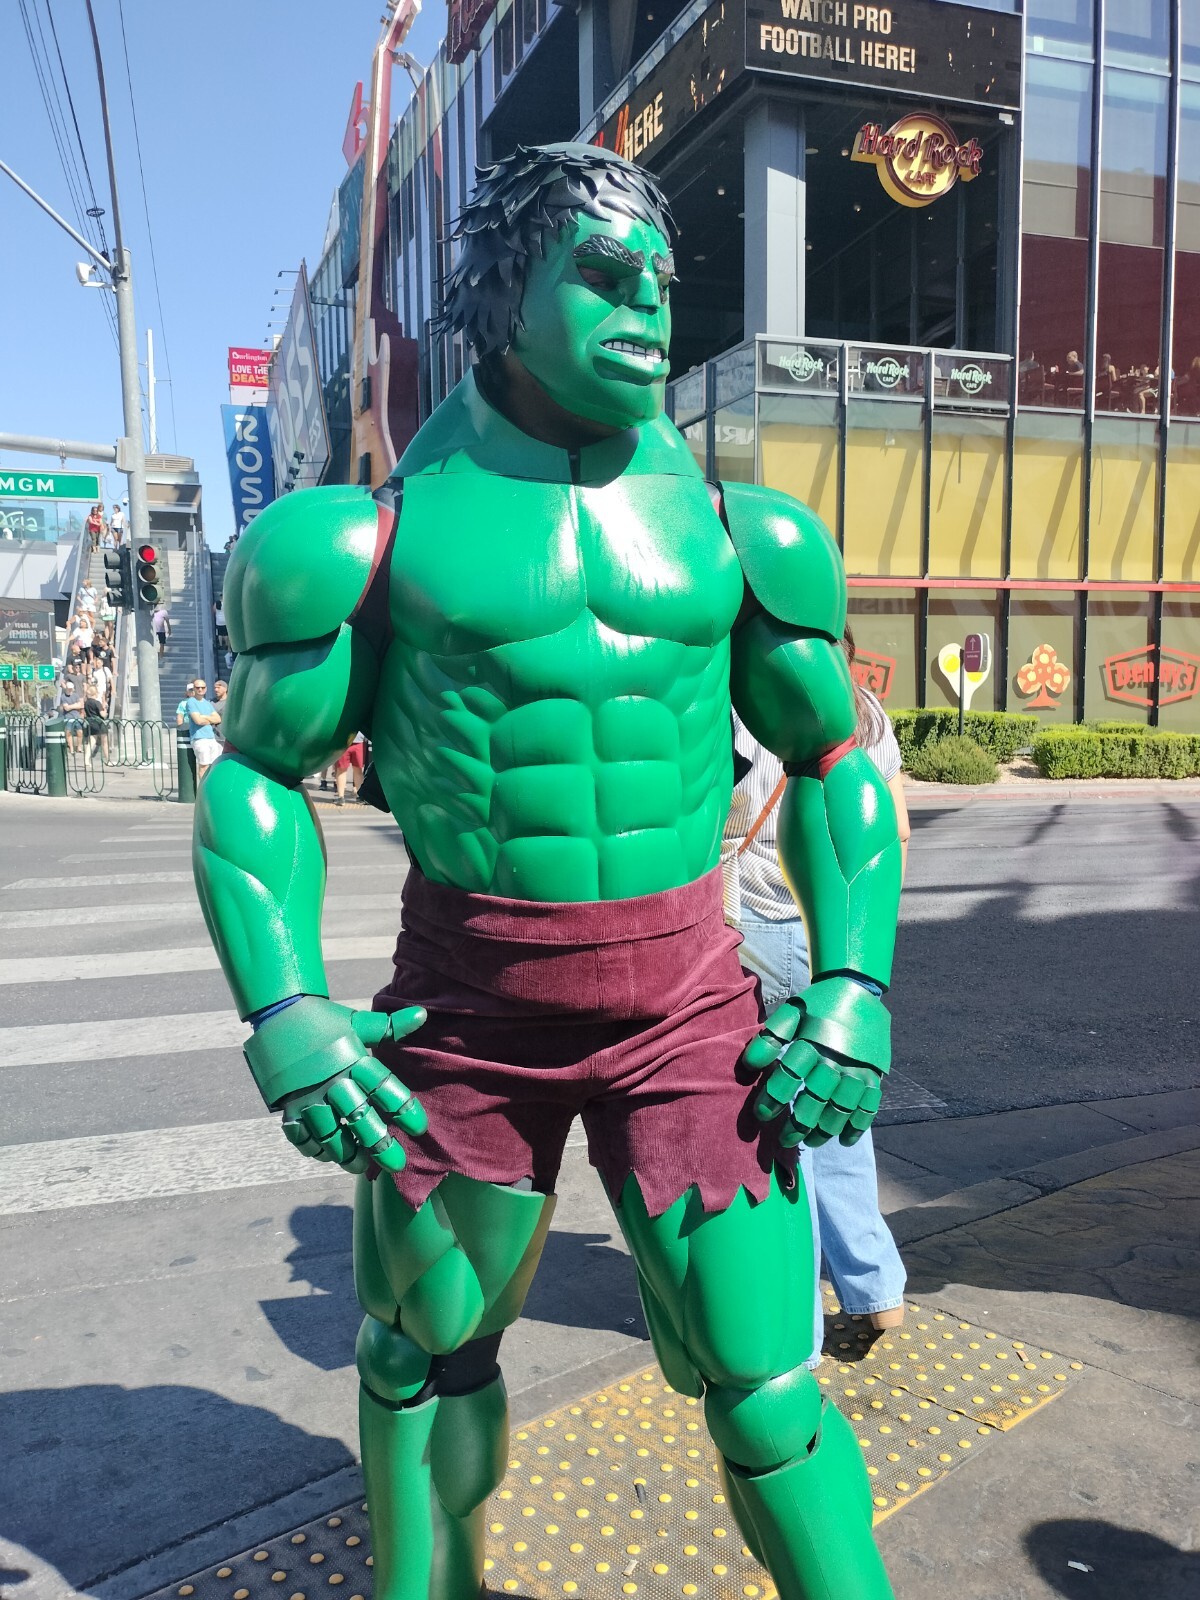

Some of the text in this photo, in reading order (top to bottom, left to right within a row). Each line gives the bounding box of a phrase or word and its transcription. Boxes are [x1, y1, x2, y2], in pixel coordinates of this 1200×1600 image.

[780, 0, 892, 35] WATCH PRO
[760, 24, 915, 74] FOOTBALL HERE!
[623, 91, 663, 162] HERE
[858, 122, 983, 175] Hard Rock
[231, 364, 269, 375] LOVE THE
[779, 355, 824, 372] Hard Rock
[866, 361, 909, 378] Hard Rock
[950, 368, 992, 384] Hard Rock
[0, 477, 55, 492] MGM
[1115, 660, 1196, 688] Denny's
